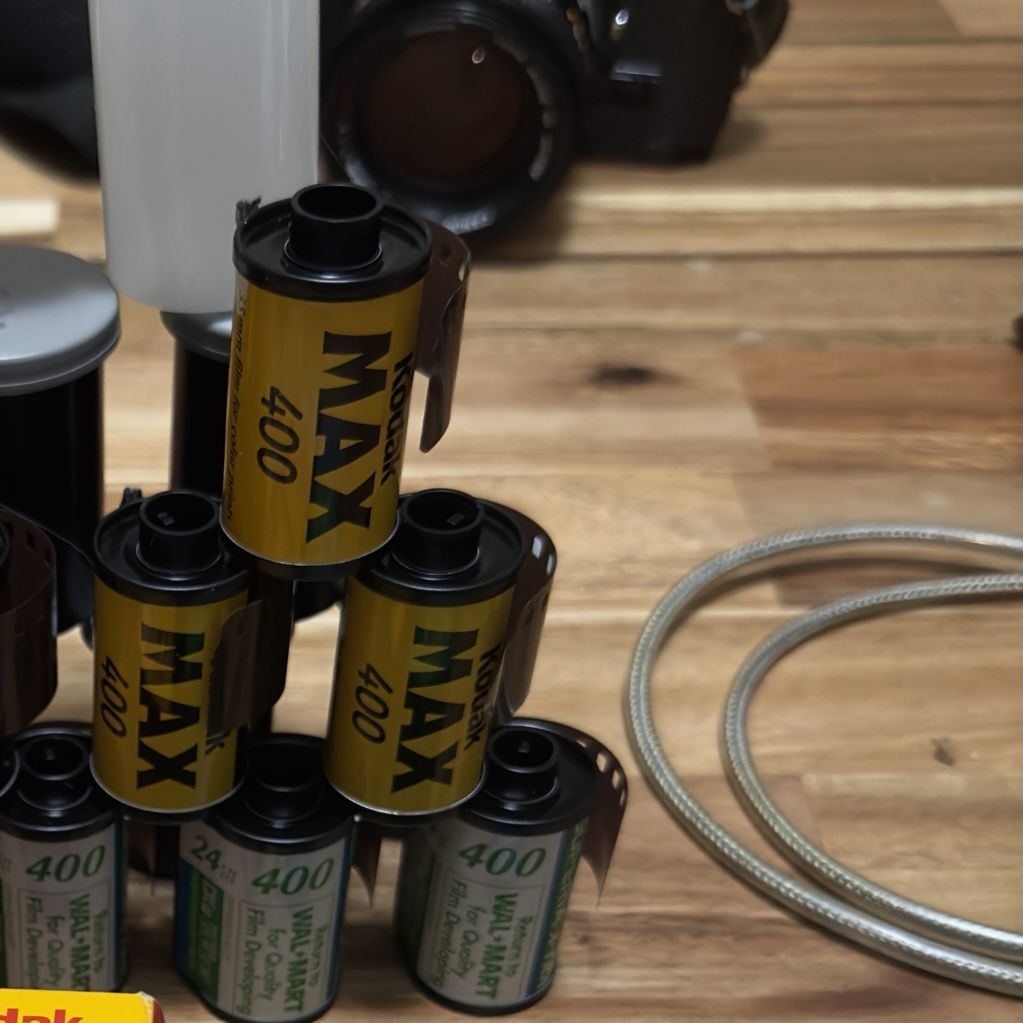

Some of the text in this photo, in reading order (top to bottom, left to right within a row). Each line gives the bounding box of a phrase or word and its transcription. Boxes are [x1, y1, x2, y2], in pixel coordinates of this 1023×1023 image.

[257, 385, 303, 485] 400
[306, 330, 392, 544] MAX
[380, 352, 415, 487] Kodak
[100, 656, 129, 739] 400
[136, 623, 206, 790] MAX
[352, 662, 394, 745] 400
[391, 626, 480, 795] MAX
[25, 844, 107, 884] 400
[189, 834, 223, 871] 24
[250, 857, 335, 896] 400
[446, 878, 468, 909] Film
[456, 842, 547, 878] 400
[245, 906, 266, 937] Film
